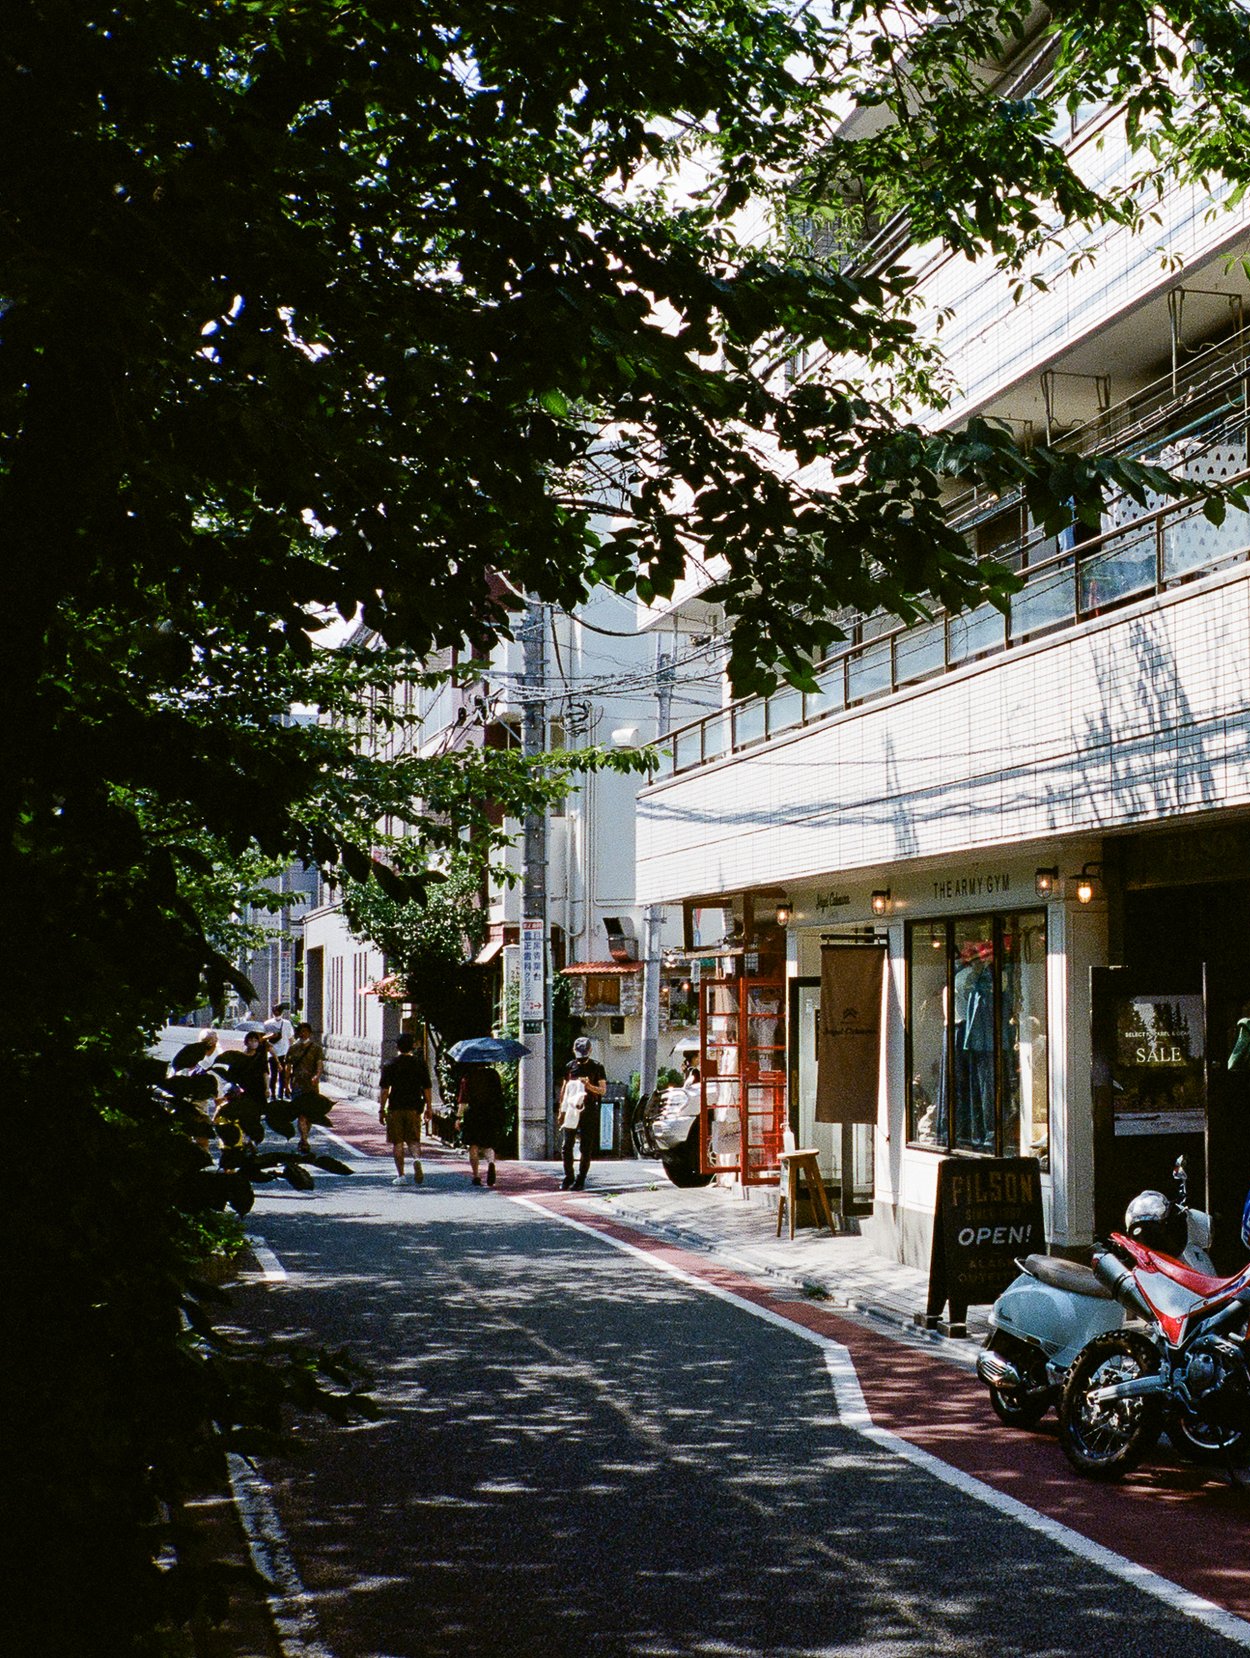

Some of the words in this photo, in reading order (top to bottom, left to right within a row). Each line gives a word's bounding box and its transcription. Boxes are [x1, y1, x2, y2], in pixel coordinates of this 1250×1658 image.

[933, 882, 952, 899] THE
[955, 879, 982, 897] ARMY
[986, 874, 1010, 894] GYM
[1136, 1047, 1182, 1063] SALE
[951, 1171, 1034, 1206] FILSON
[957, 1223, 1033, 1247] OPEN!
